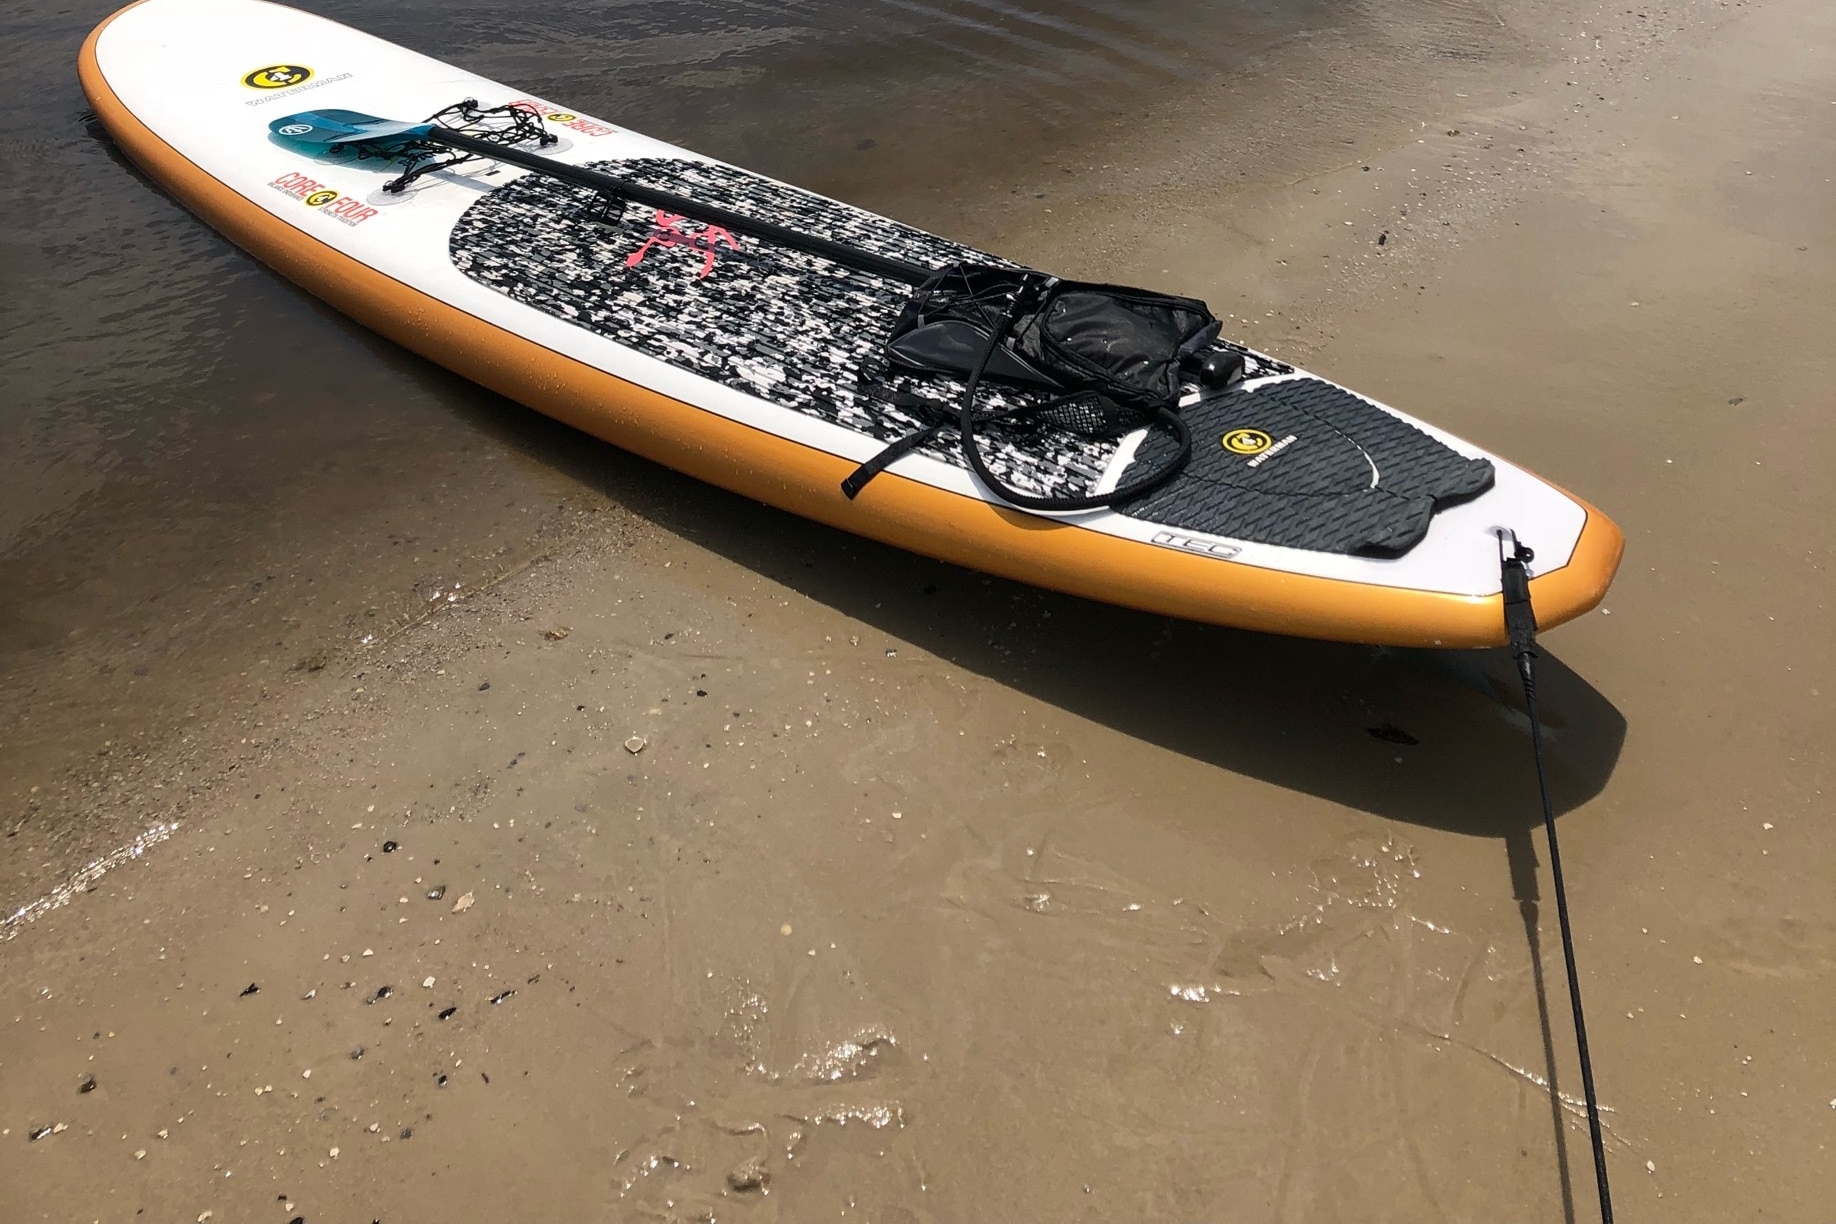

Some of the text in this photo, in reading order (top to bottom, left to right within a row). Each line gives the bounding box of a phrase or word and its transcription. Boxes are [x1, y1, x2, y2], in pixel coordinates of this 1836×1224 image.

[245, 72, 354, 107] WATERMAN
[274, 172, 326, 197] CORE
[324, 196, 379, 225] FOUR
[1246, 434, 1298, 468] WATERMAN
